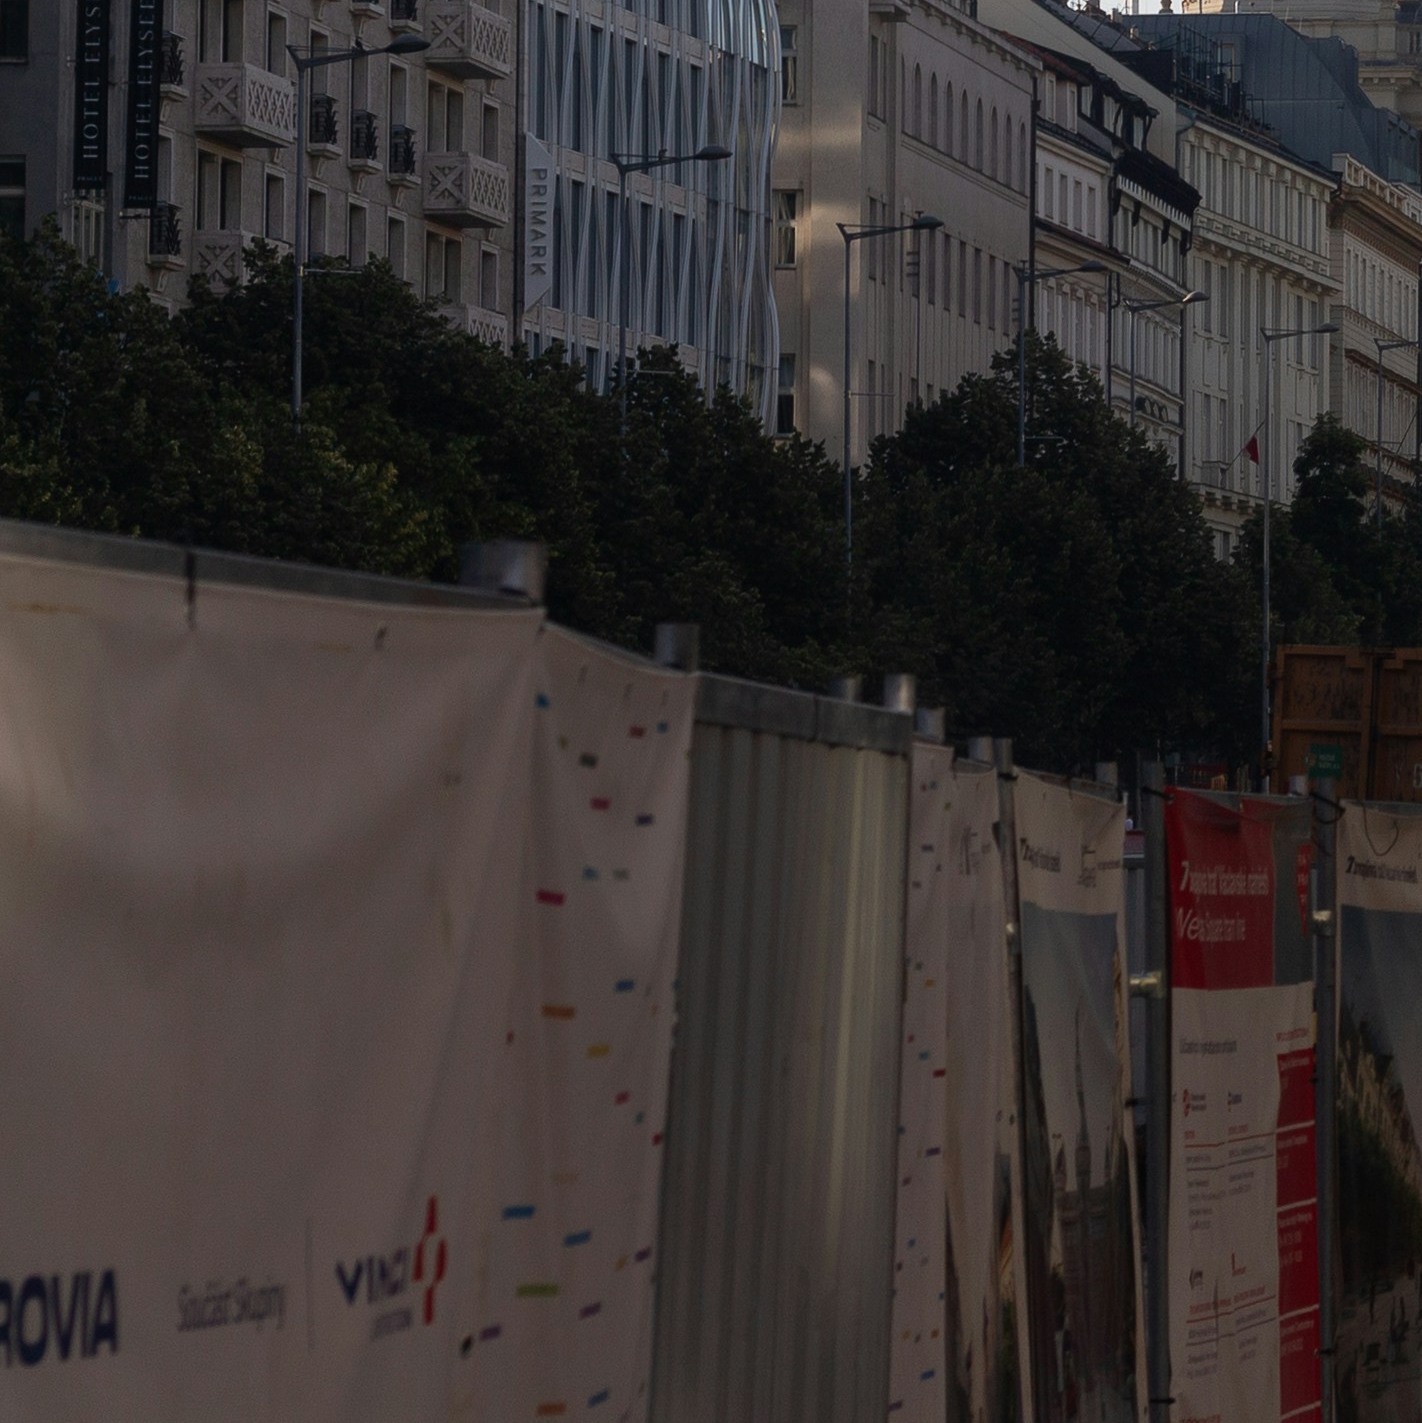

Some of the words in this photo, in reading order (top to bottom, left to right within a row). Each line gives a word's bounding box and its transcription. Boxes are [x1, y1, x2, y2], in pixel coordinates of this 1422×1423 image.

[83, 81, 101, 159] HOTEL
[134, 98, 152, 179] HOTEL
[531, 168, 548, 276] PRIMARK
